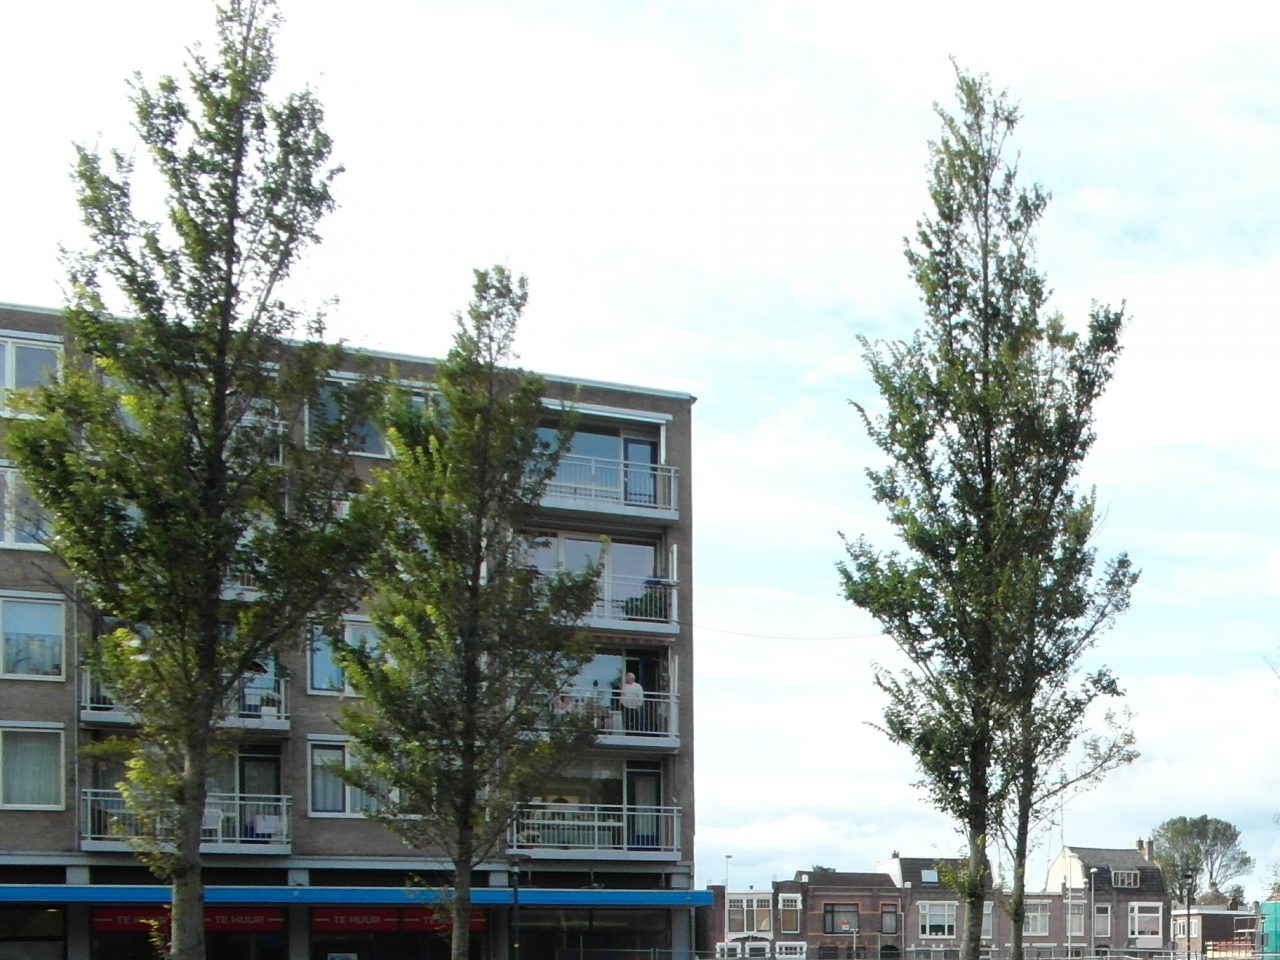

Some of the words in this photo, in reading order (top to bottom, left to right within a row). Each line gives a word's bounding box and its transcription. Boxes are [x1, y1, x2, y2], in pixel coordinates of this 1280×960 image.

[116, 915, 130, 925] TE
[215, 915, 229, 925] TE
[231, 915, 265, 925] HUUR
[333, 915, 347, 925] TE
[349, 915, 381, 925] HUUR
